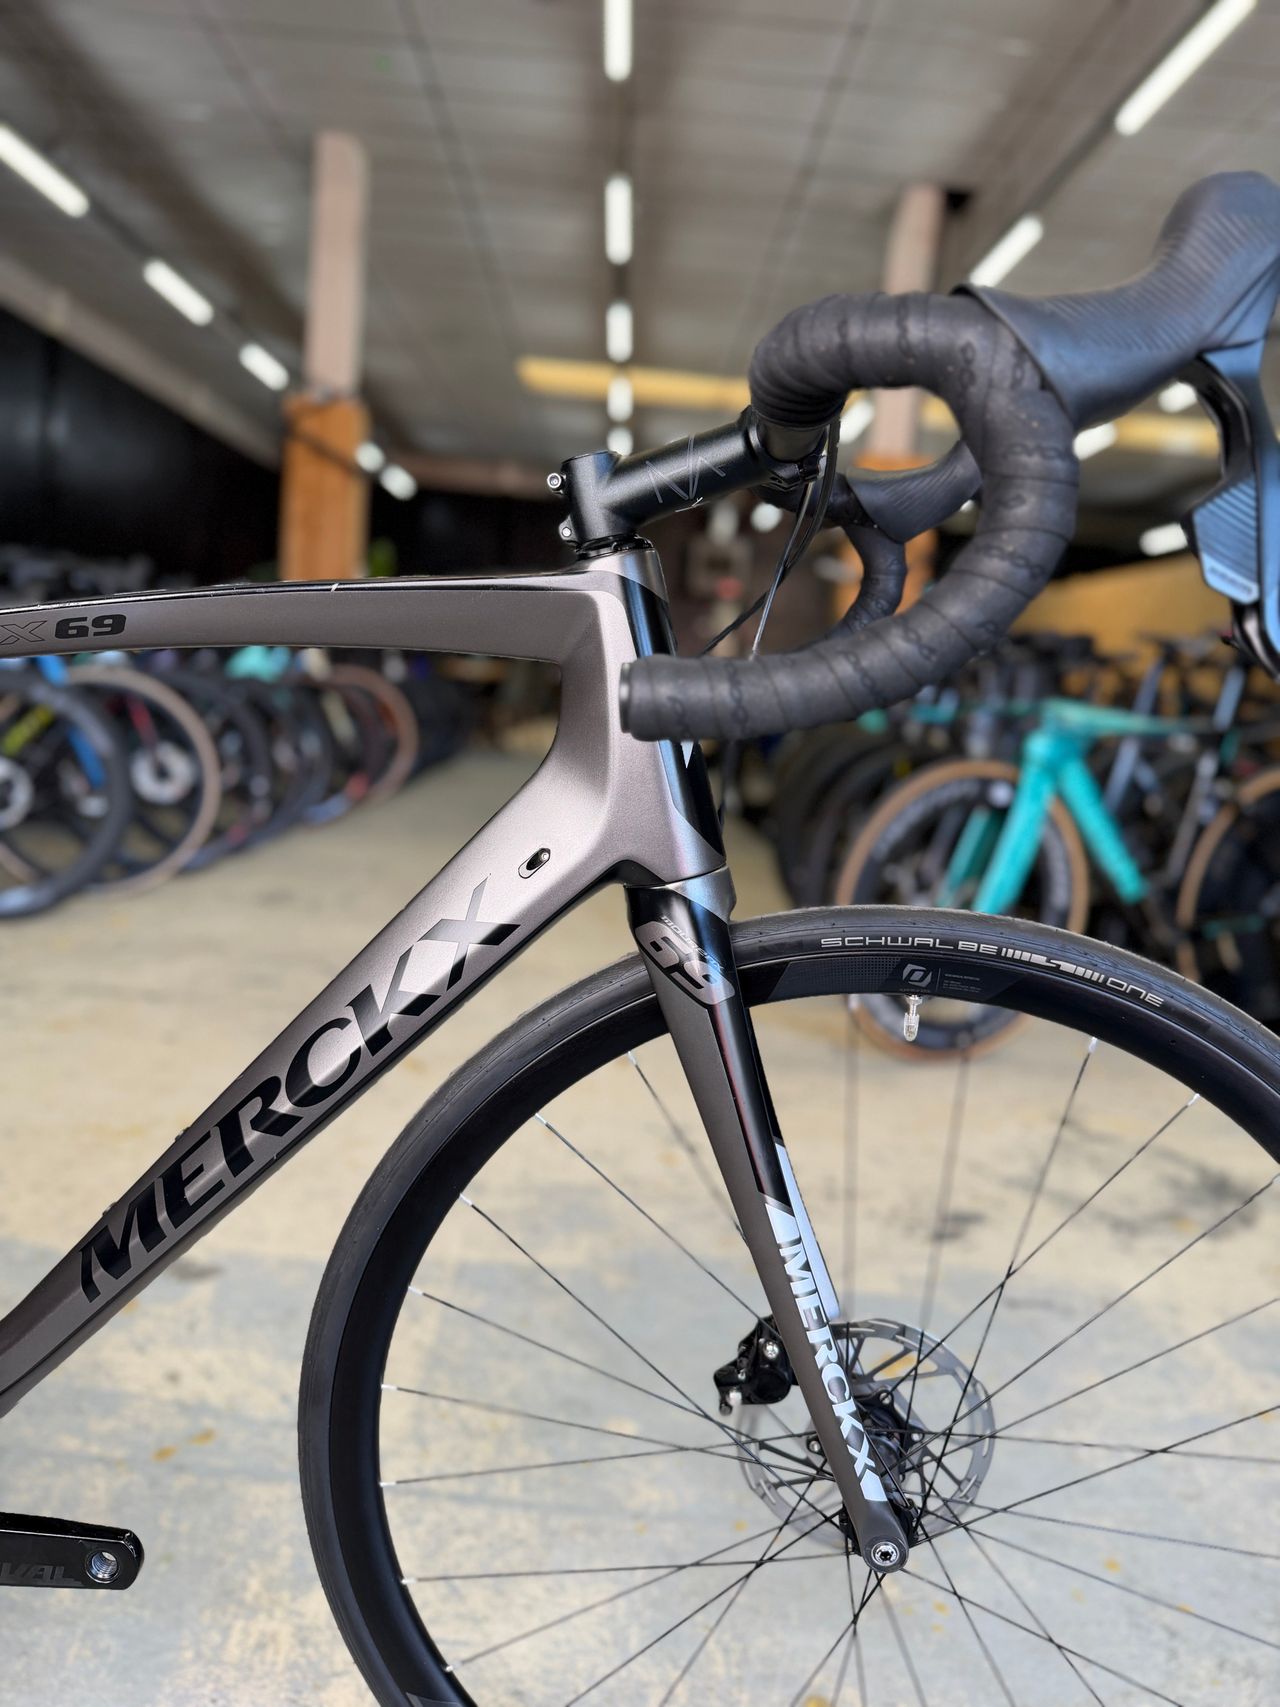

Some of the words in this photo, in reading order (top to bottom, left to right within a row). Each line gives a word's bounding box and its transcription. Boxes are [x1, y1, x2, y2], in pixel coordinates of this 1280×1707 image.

[55, 614, 127, 639] 69
[635, 920, 736, 1005] 69
[820, 936, 998, 957] SCHWALBE
[79, 876, 521, 1304] MERCKX
[779, 1242, 876, 1479] MERCKX
